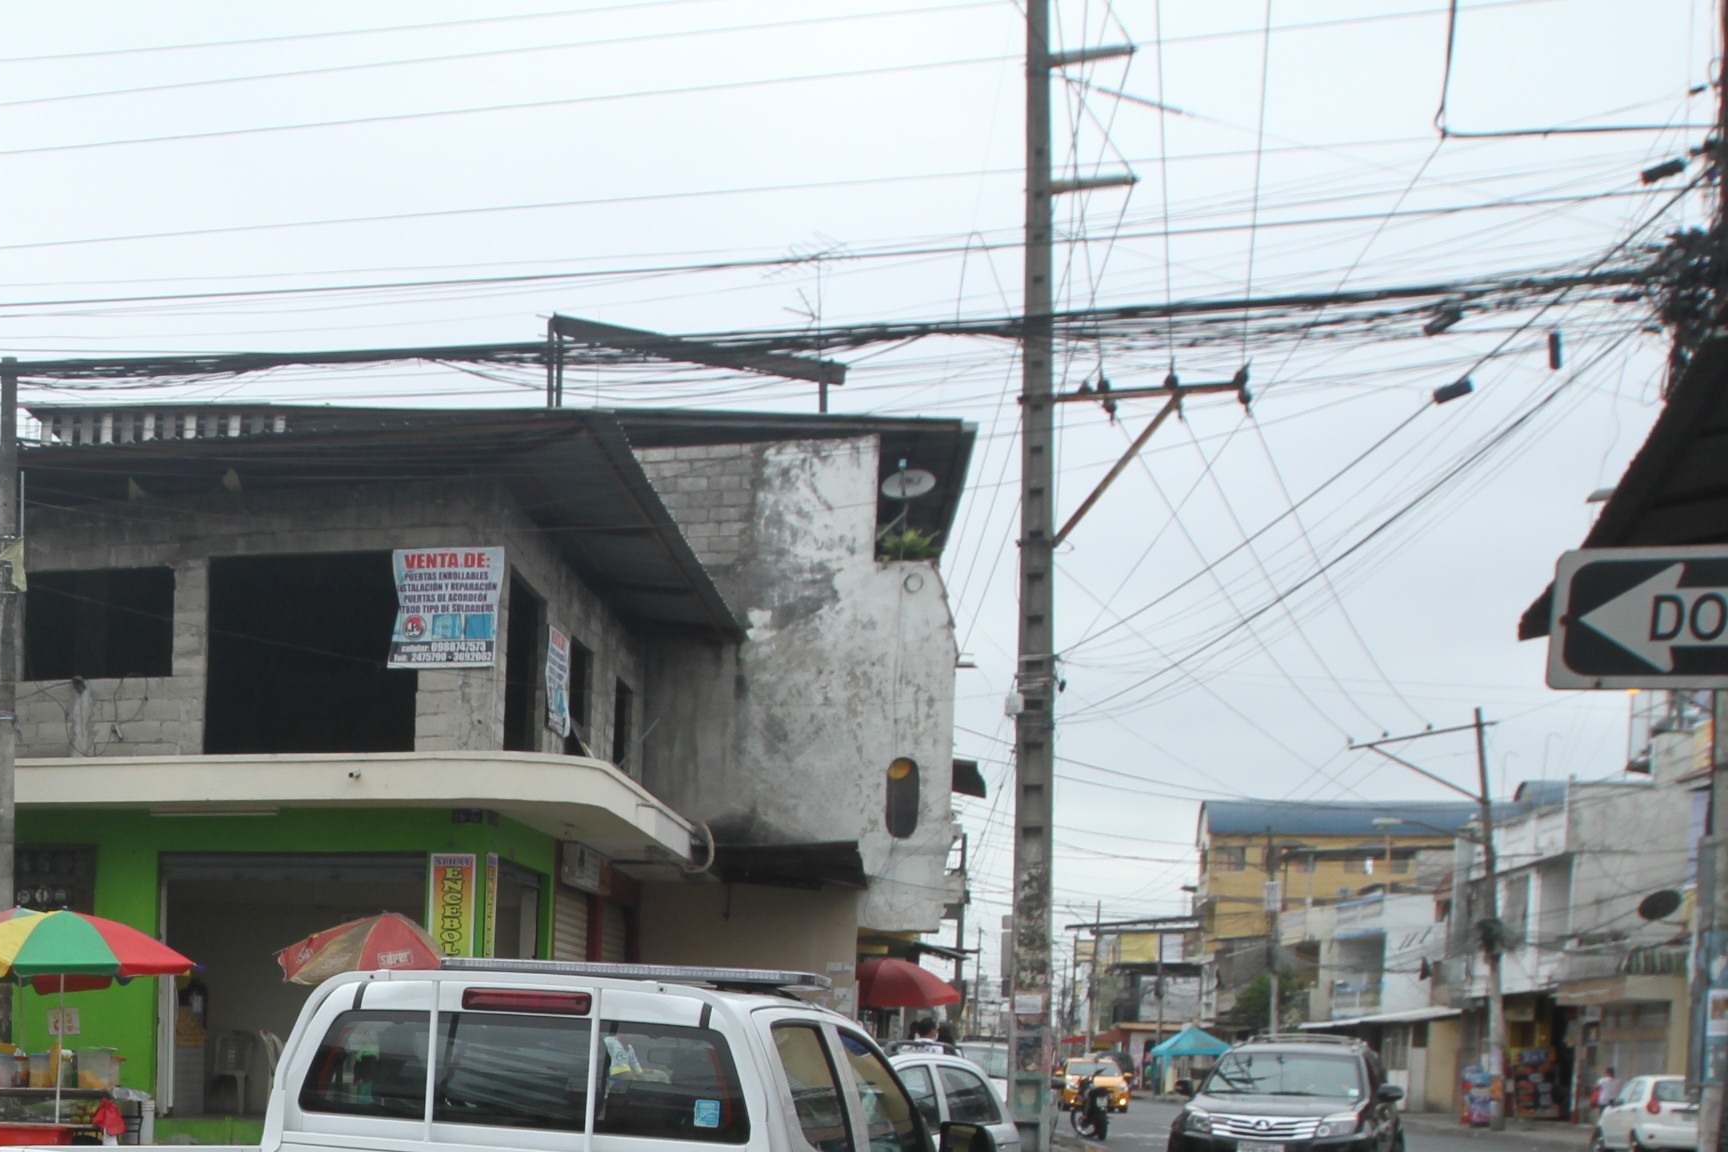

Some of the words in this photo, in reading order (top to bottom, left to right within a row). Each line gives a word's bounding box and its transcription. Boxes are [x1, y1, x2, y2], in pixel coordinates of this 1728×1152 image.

[404, 553, 459, 569] VENTA
[464, 552, 491, 568] DE:
[404, 572, 437, 582] PUERTAS
[439, 571, 489, 581] ENROLLABLES
[445, 583, 450, 591] Y
[404, 593, 437, 603] PUERTAS
[438, 593, 447, 602] DE
[423, 604, 439, 613] TIPO
[441, 604, 450, 612] DE
